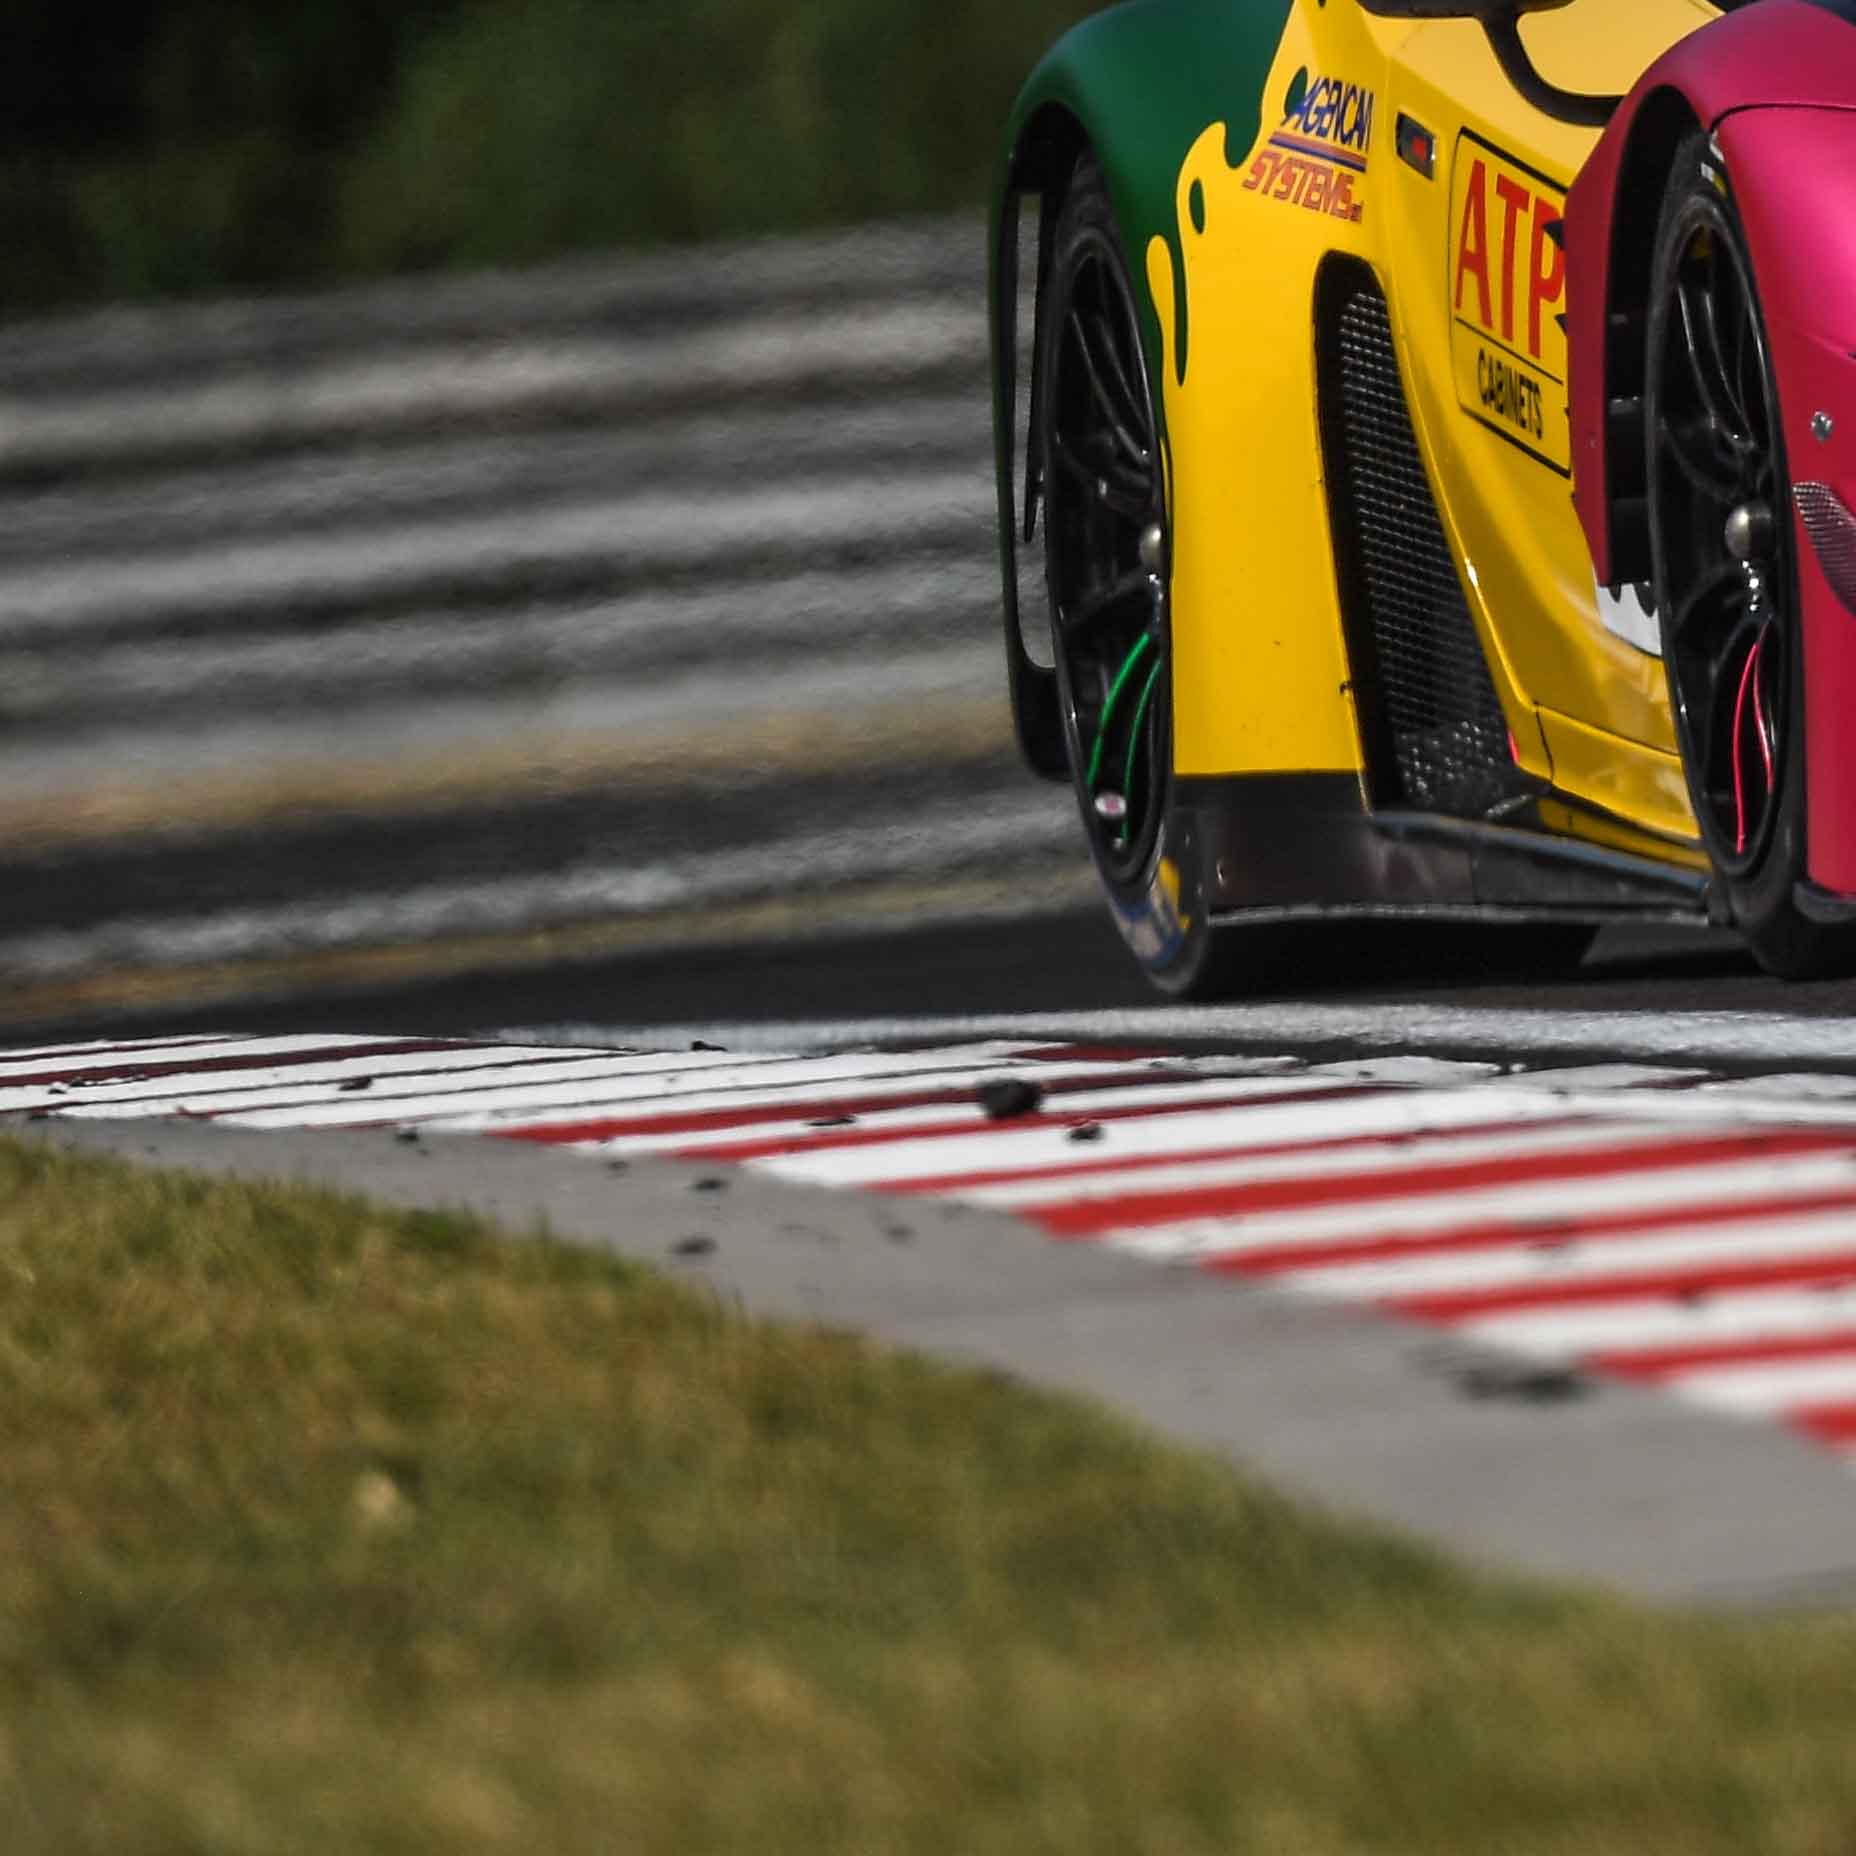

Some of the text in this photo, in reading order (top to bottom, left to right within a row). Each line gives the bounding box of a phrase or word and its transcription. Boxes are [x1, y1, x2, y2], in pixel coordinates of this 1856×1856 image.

[1242, 149, 1354, 220] SYSTEMS
[1455, 159, 1566, 360] ATP
[1478, 348, 1542, 440] CABINETS
